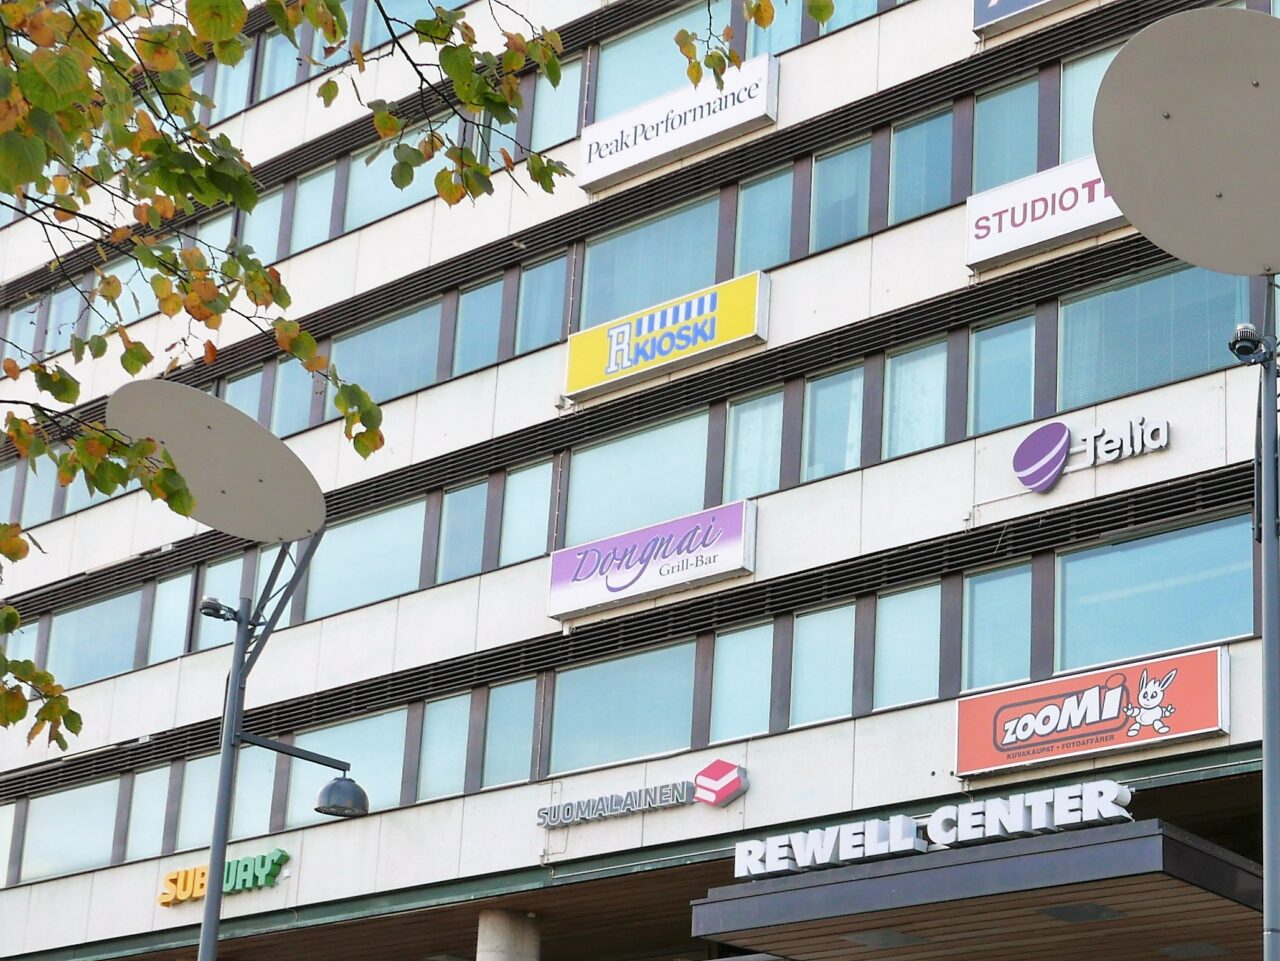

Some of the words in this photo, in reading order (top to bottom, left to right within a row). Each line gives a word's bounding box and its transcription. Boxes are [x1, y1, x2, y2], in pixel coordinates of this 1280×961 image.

[632, 317, 716, 365] KIOSKI
[1081, 416, 1170, 466] Telia
[572, 516, 723, 592] Dongnai
[659, 553, 719, 577] Grill-Bar
[1006, 745, 1055, 760] KUVAKAUPAT
[1061, 734, 1115, 749] FOTOAFFÄRER
[536, 781, 688, 829] SUOMALAINEN
[734, 815, 927, 879] REWELL
[927, 779, 1134, 846] CENTER
